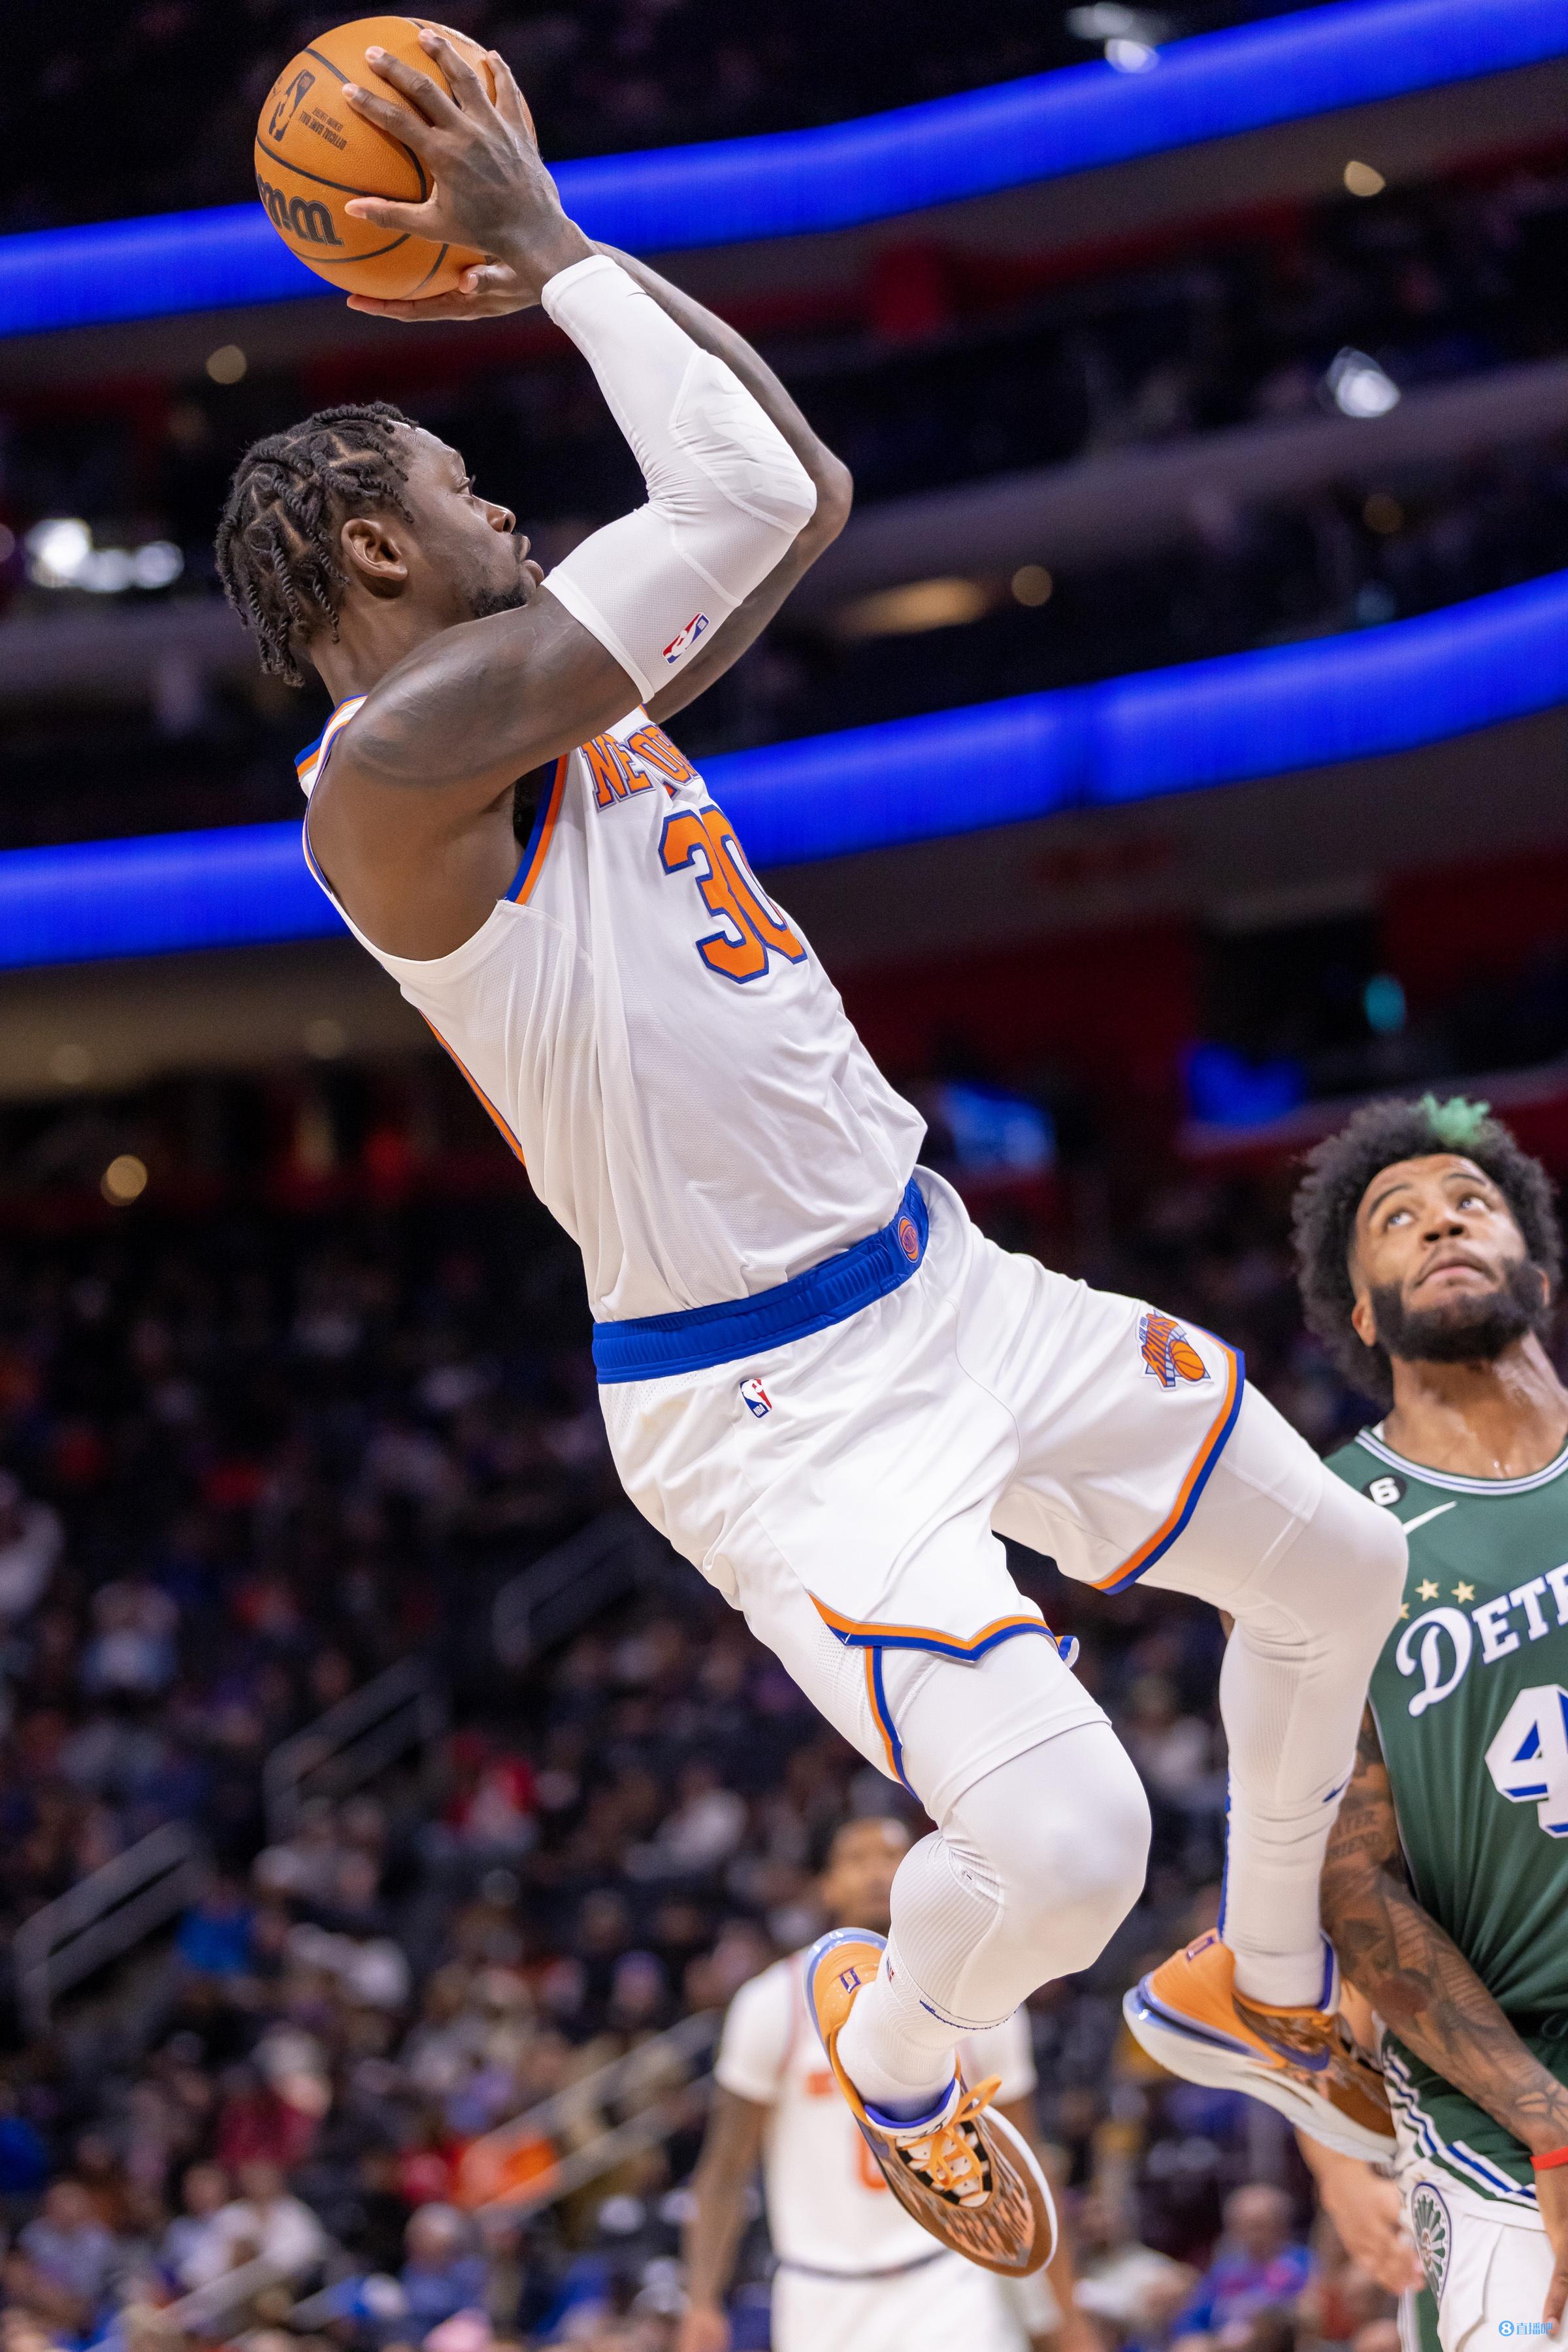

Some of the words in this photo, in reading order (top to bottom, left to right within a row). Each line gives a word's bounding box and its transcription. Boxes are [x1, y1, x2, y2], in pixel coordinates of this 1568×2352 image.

[658, 804, 808, 985] 30
[1142, 1313, 1178, 1387] KNICKS
[753, 1403, 766, 1417] NBA
[1369, 1478, 1399, 1505] 6
